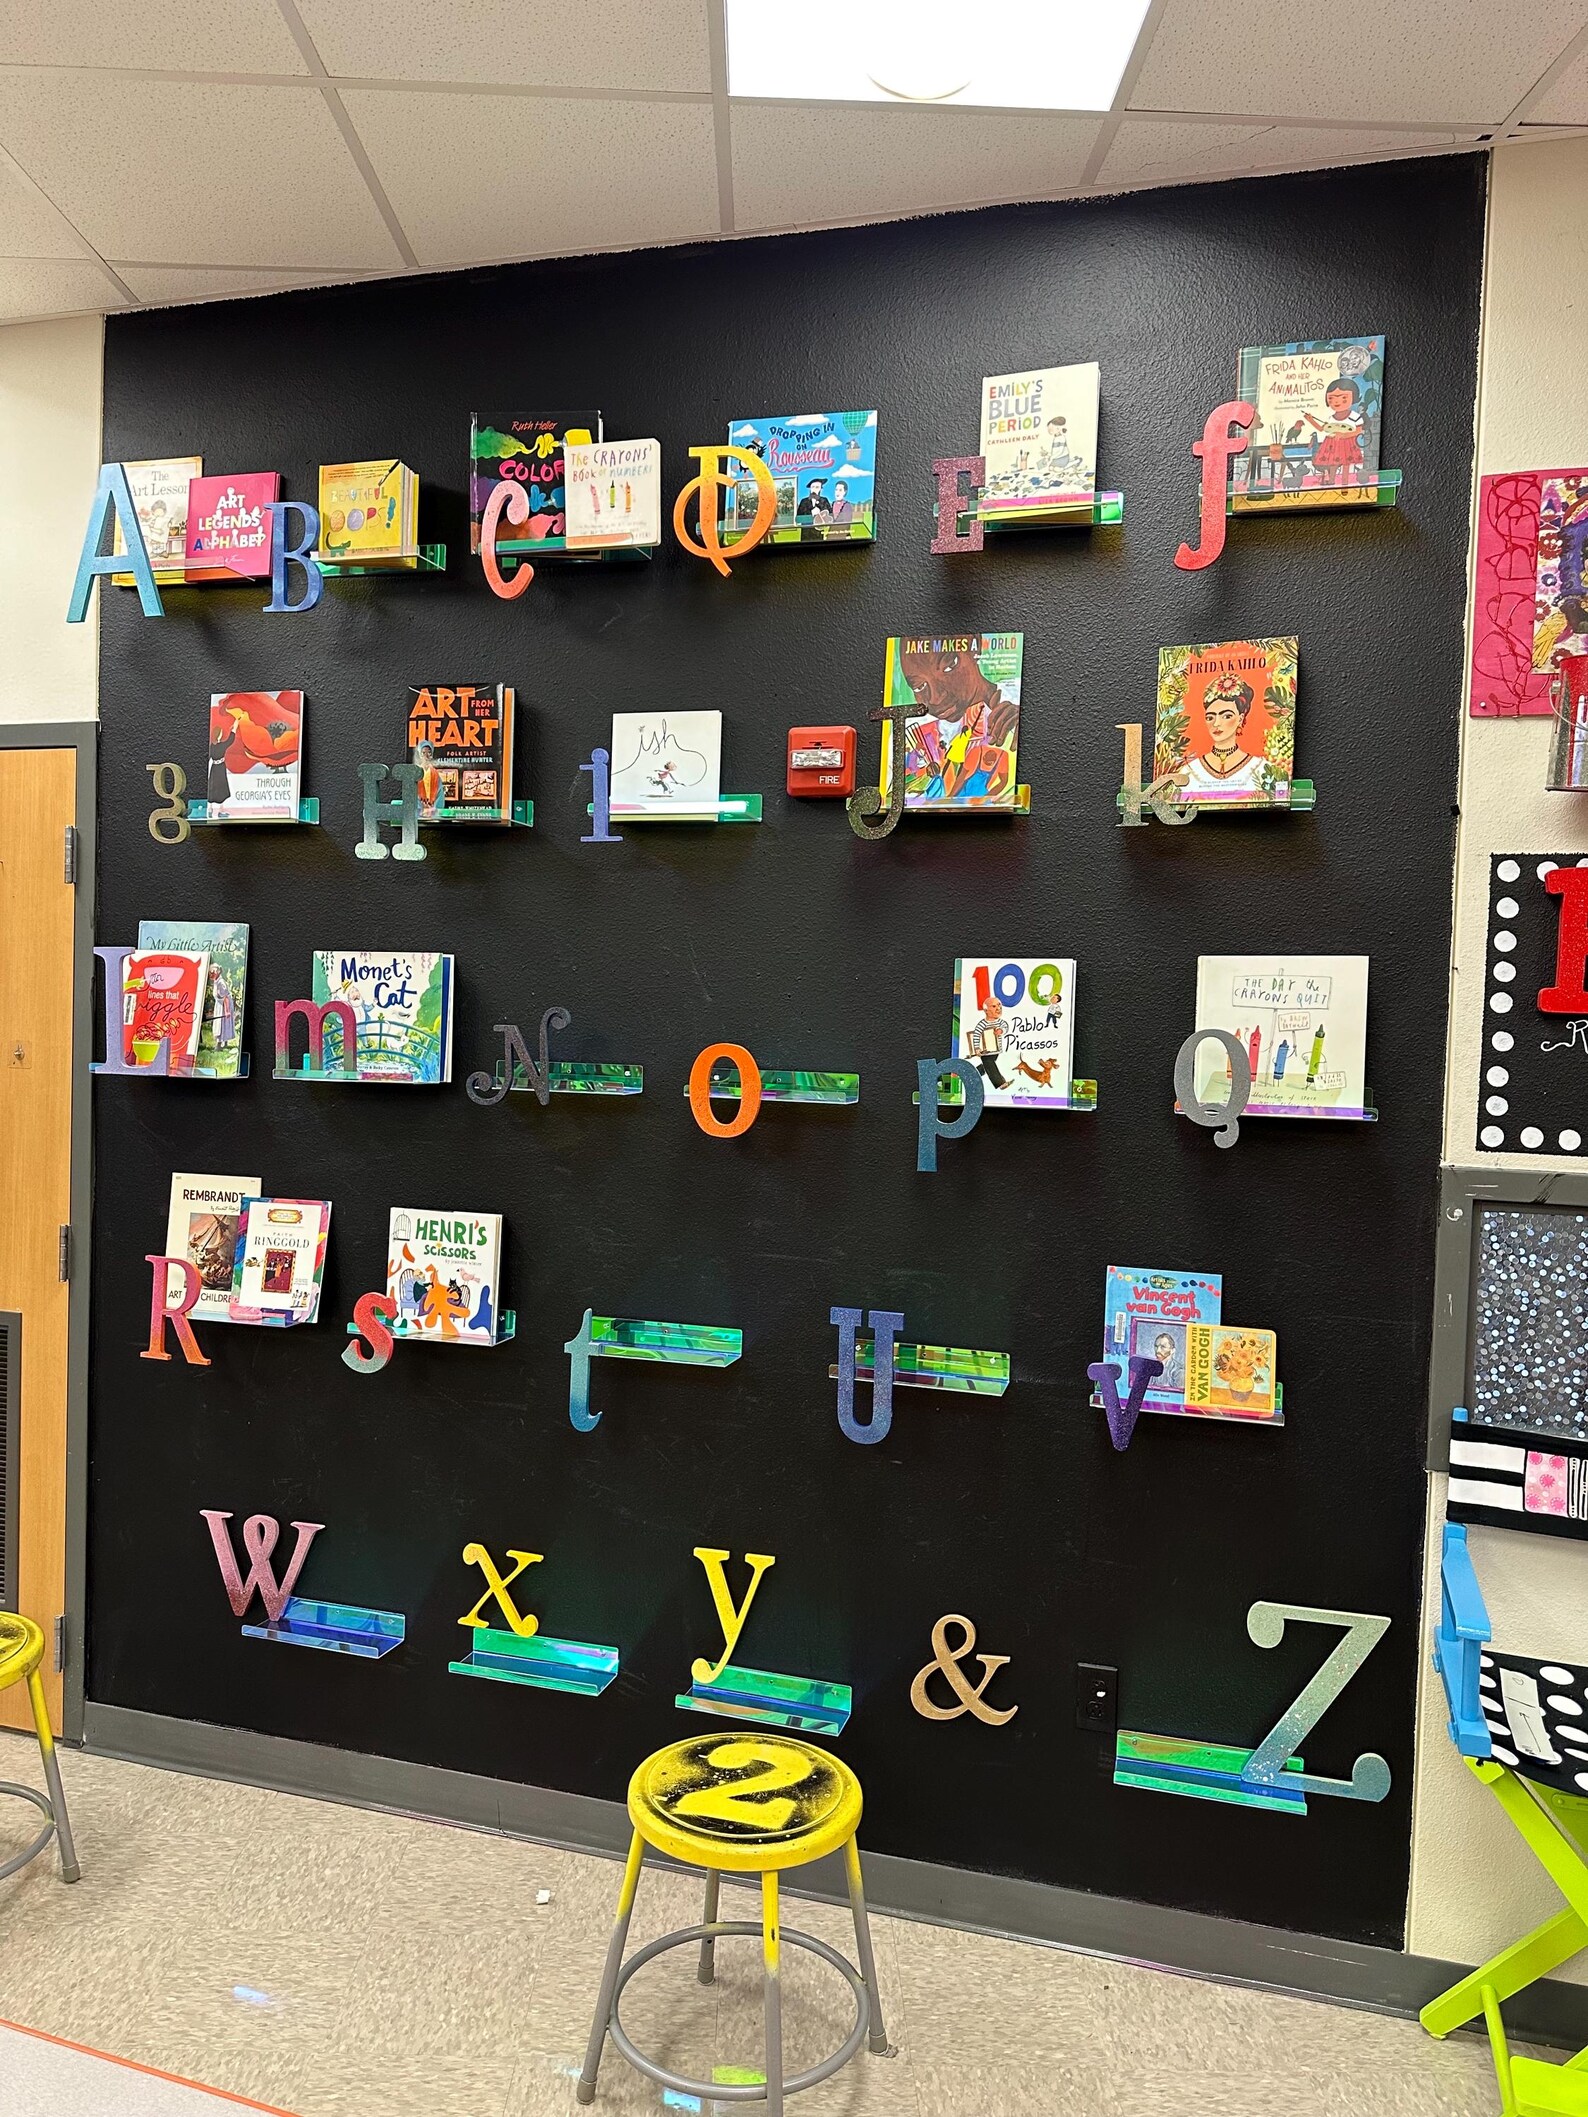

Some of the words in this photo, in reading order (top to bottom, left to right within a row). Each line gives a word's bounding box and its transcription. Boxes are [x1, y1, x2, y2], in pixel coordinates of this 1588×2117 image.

[1265, 359, 1296, 375] FRIDA
[1300, 356, 1333, 372] KAHLO
[988, 394, 1042, 421] BLUE
[511, 420, 534, 431] Ruth
[534, 420, 559, 431] Heller
[768, 425, 821, 444] DROPPING
[822, 422, 836, 434] IN
[987, 436, 1021, 445] CATHLEEN
[1022, 433, 1040, 442] DALY
[571, 453, 589, 467] The
[767, 438, 836, 473] Rousseau
[796, 443, 808, 451] ON
[151, 470, 169, 482] The
[1173, 400, 1256, 572] f
[216, 493, 246, 510] ART
[673, 444, 778, 578] D
[930, 455, 986, 555] E
[198, 512, 263, 532] LEGENDS
[66, 462, 165, 623] A
[193, 532, 267, 552] ALPHABET
[480, 479, 535, 600] C
[263, 501, 325, 614] B
[905, 639, 930, 655] JAKE
[932, 637, 968, 653] MAKES
[970, 637, 978, 651] A
[981, 637, 1017, 651] WORLD
[409, 686, 476, 719] ART
[471, 699, 494, 708] FROM
[474, 708, 490, 717] HER
[408, 719, 499, 748] HEART
[637, 718, 679, 755] ish
[256, 777, 291, 788] THROUGH
[818, 775, 840, 785] FIRE
[848, 702, 929, 840] J
[145, 762, 192, 845] g
[235, 790, 272, 801] GEORGIA'S
[274, 789, 291, 801] EYES
[579, 747, 624, 842] i
[355, 763, 428, 861] H
[146, 936, 166, 950] My
[167, 937, 200, 951] Little
[201, 937, 238, 952] Artist
[341, 956, 413, 983] Monet's
[148, 990, 165, 999] lines
[165, 990, 180, 1000] that
[374, 980, 417, 1009] Cat
[972, 963, 1063, 1012] 100
[1234, 988, 1289, 1005] CRAYONS
[1296, 992, 1328, 1006] QUIT
[1244, 978, 1264, 988] THE
[1271, 978, 1296, 991] DAY
[1306, 979, 1321, 992] the
[92, 946, 171, 1075] L
[1011, 1016, 1044, 1034] Pablo
[275, 1000, 357, 1073] m
[1003, 1033, 1059, 1052] Picassos
[466, 1006, 572, 1106] N
[1174, 1028, 1251, 1149] Q
[253, 1235, 310, 1249] RINGGOLD
[415, 1217, 488, 1247] HENRI'S
[168, 1290, 183, 1299] ART
[1132, 1285, 1196, 1304] Vincent
[140, 1254, 211, 1365] R
[1125, 1301, 1158, 1315] van
[1160, 1300, 1201, 1322] Gogh
[1198, 1327, 1211, 1370] GOGH
[564, 1307, 603, 1433] t
[829, 1306, 905, 1445] U
[1197, 1370, 1210, 1402] VAN
[200, 1509, 327, 1622] W
[909, 1613, 1019, 1726] &
[1240, 1600, 1392, 1803] Z
[671, 1741, 811, 1831] 2
